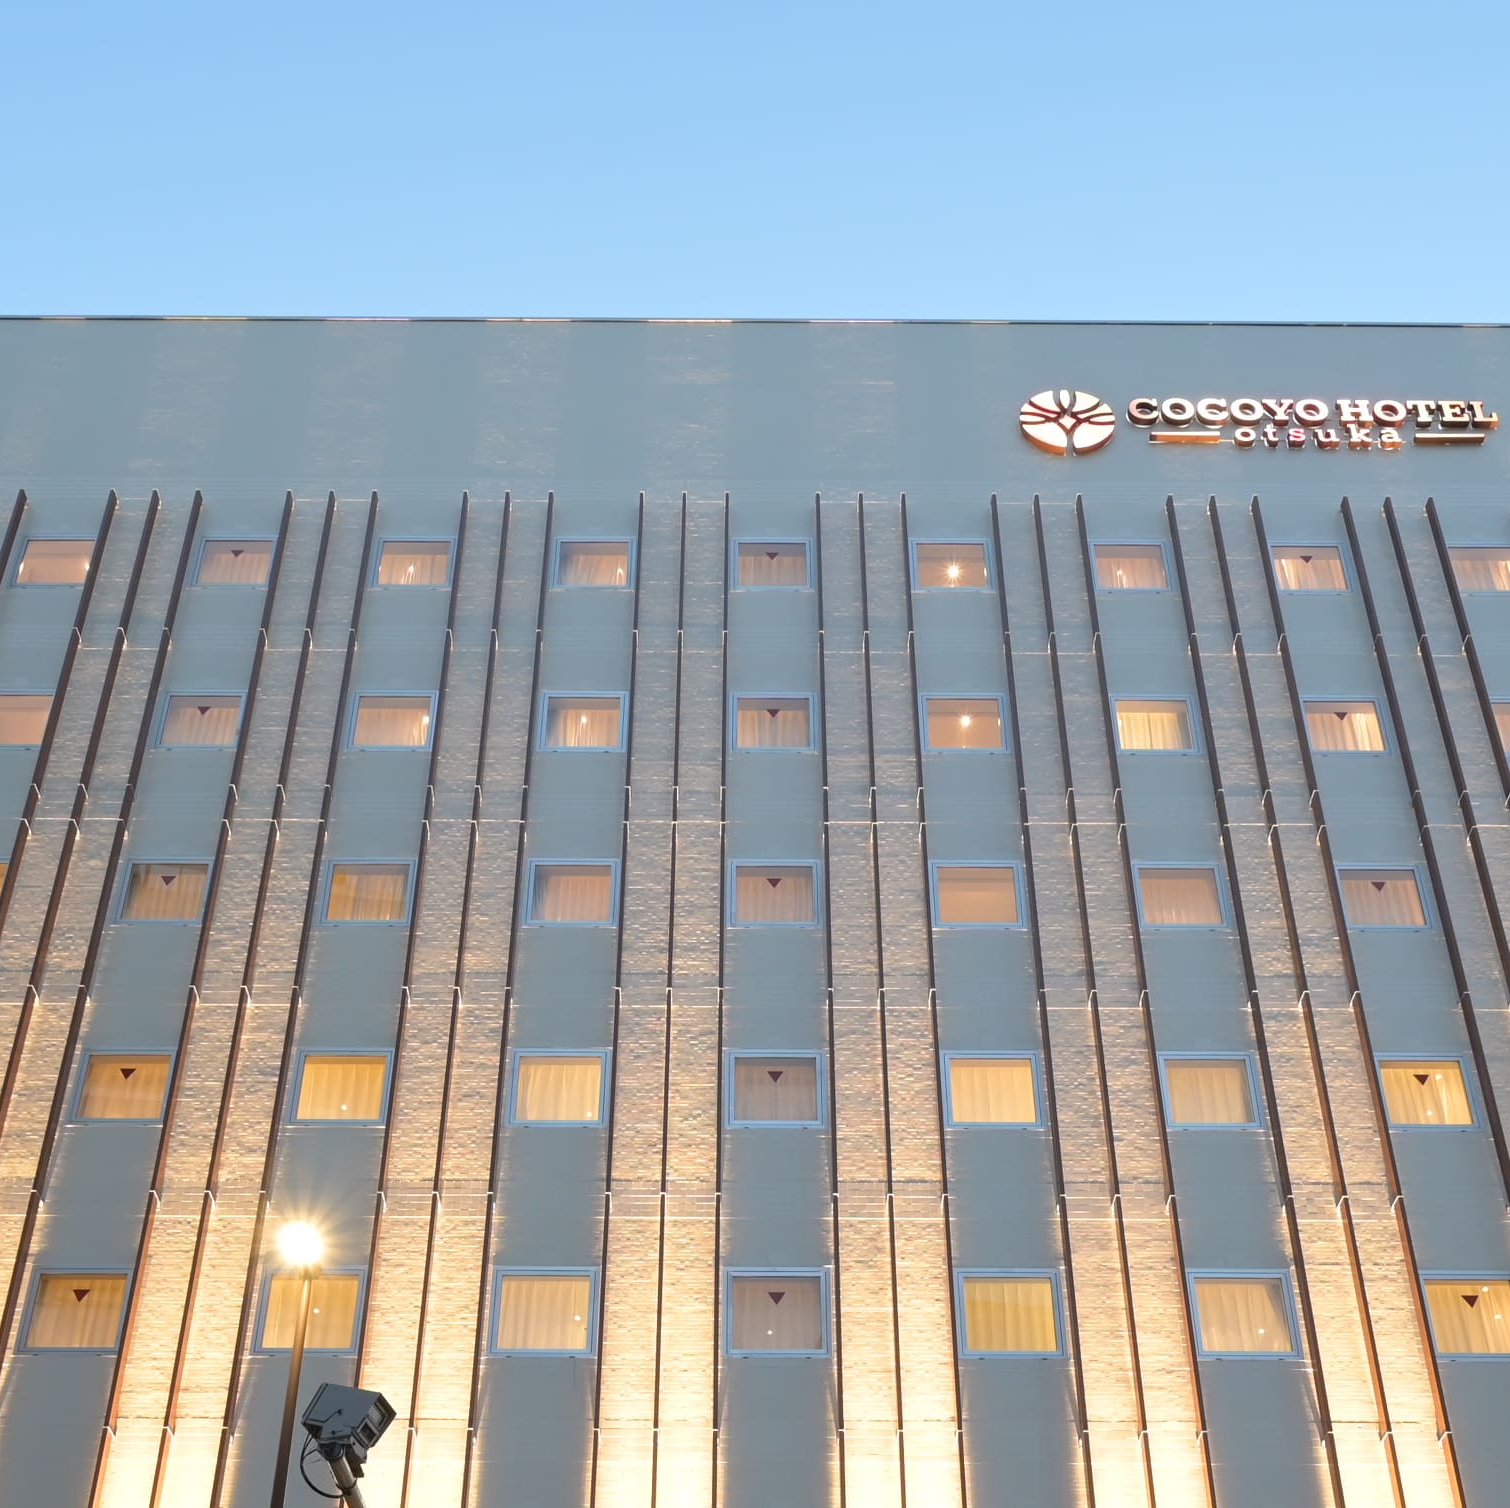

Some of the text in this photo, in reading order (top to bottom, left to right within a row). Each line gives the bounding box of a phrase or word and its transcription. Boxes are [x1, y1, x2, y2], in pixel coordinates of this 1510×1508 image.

[1126, 397, 1499, 429] COCOYO HOTEL
[1234, 423, 1403, 449] otsuka
